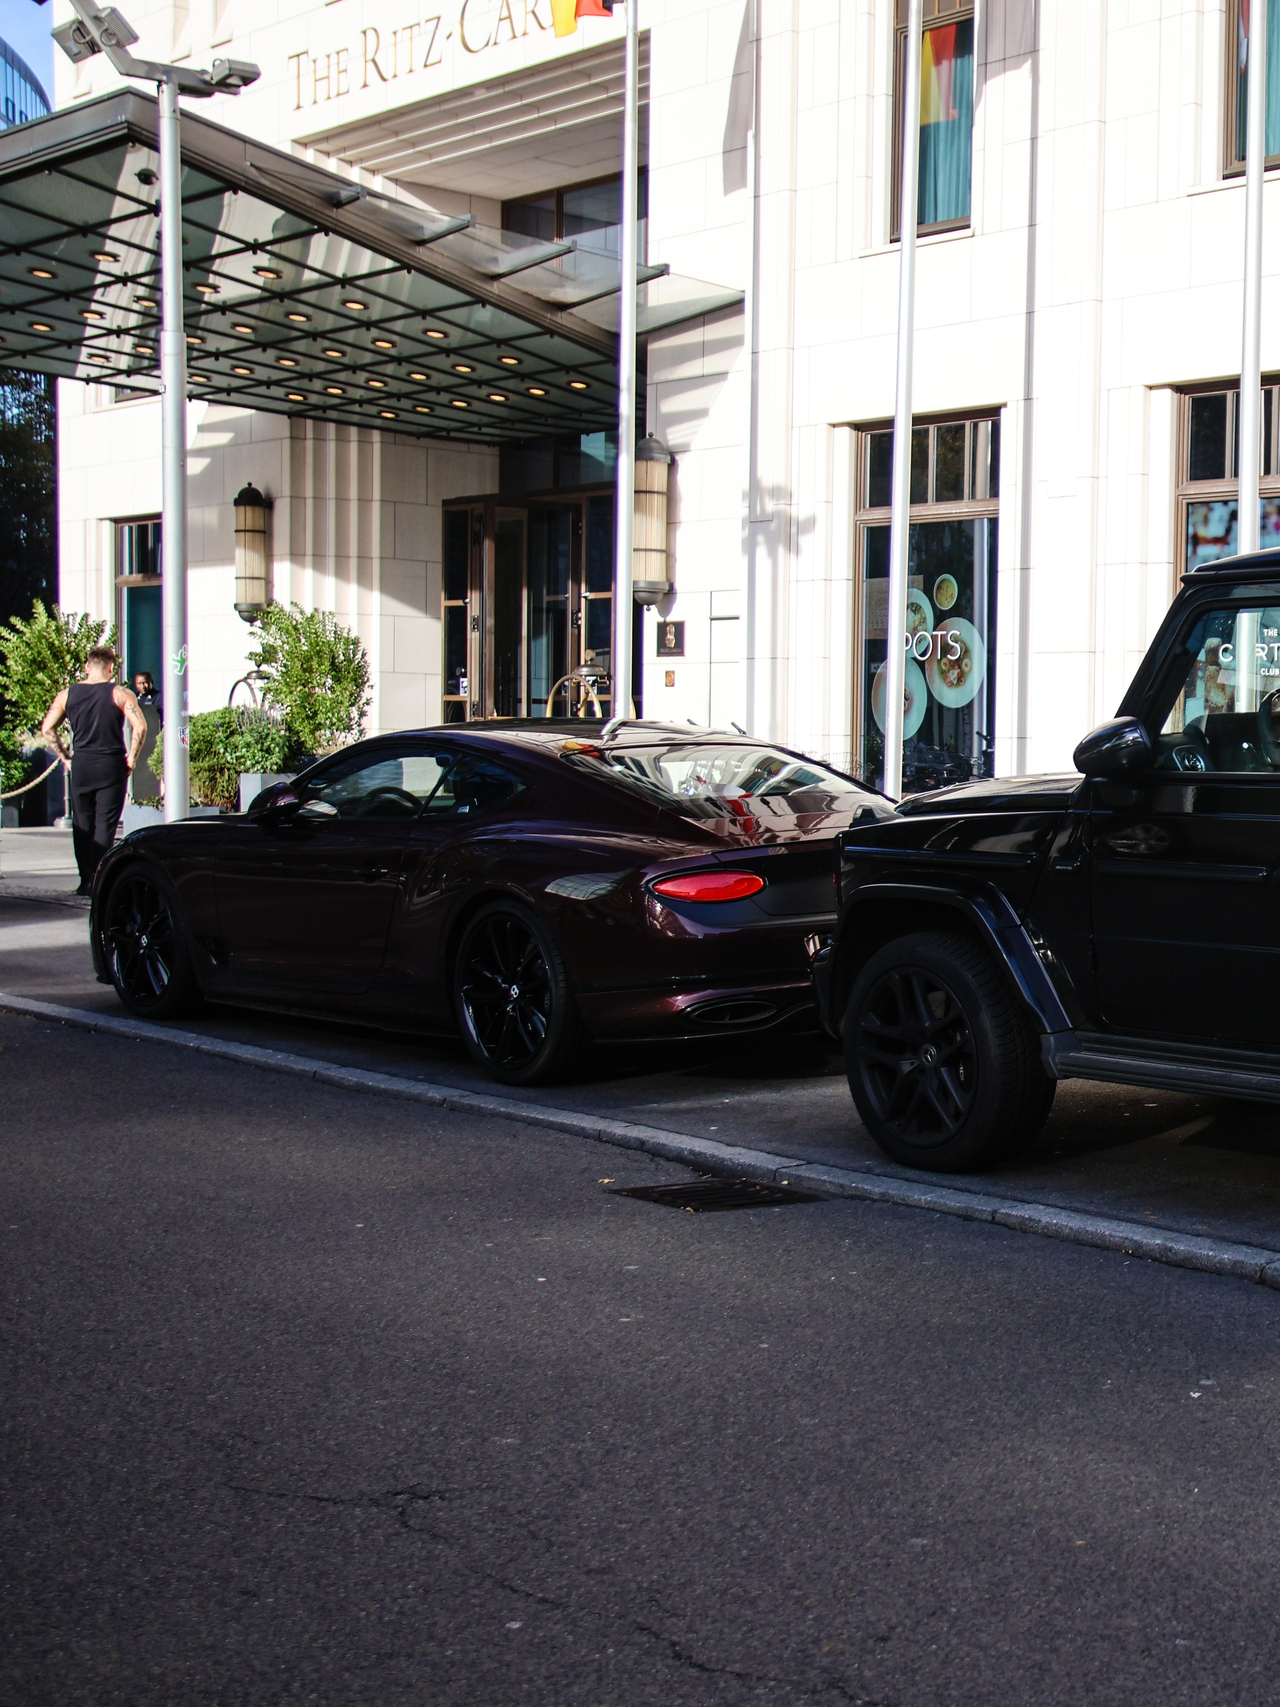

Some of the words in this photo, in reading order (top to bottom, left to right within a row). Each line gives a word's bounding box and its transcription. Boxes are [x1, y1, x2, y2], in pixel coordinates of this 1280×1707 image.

[287, 48, 350, 111] THE
[360, 0, 554, 89] RITZ-CAR
[1263, 628, 1279, 637] THE
[1260, 667, 1280, 676] CLUB
